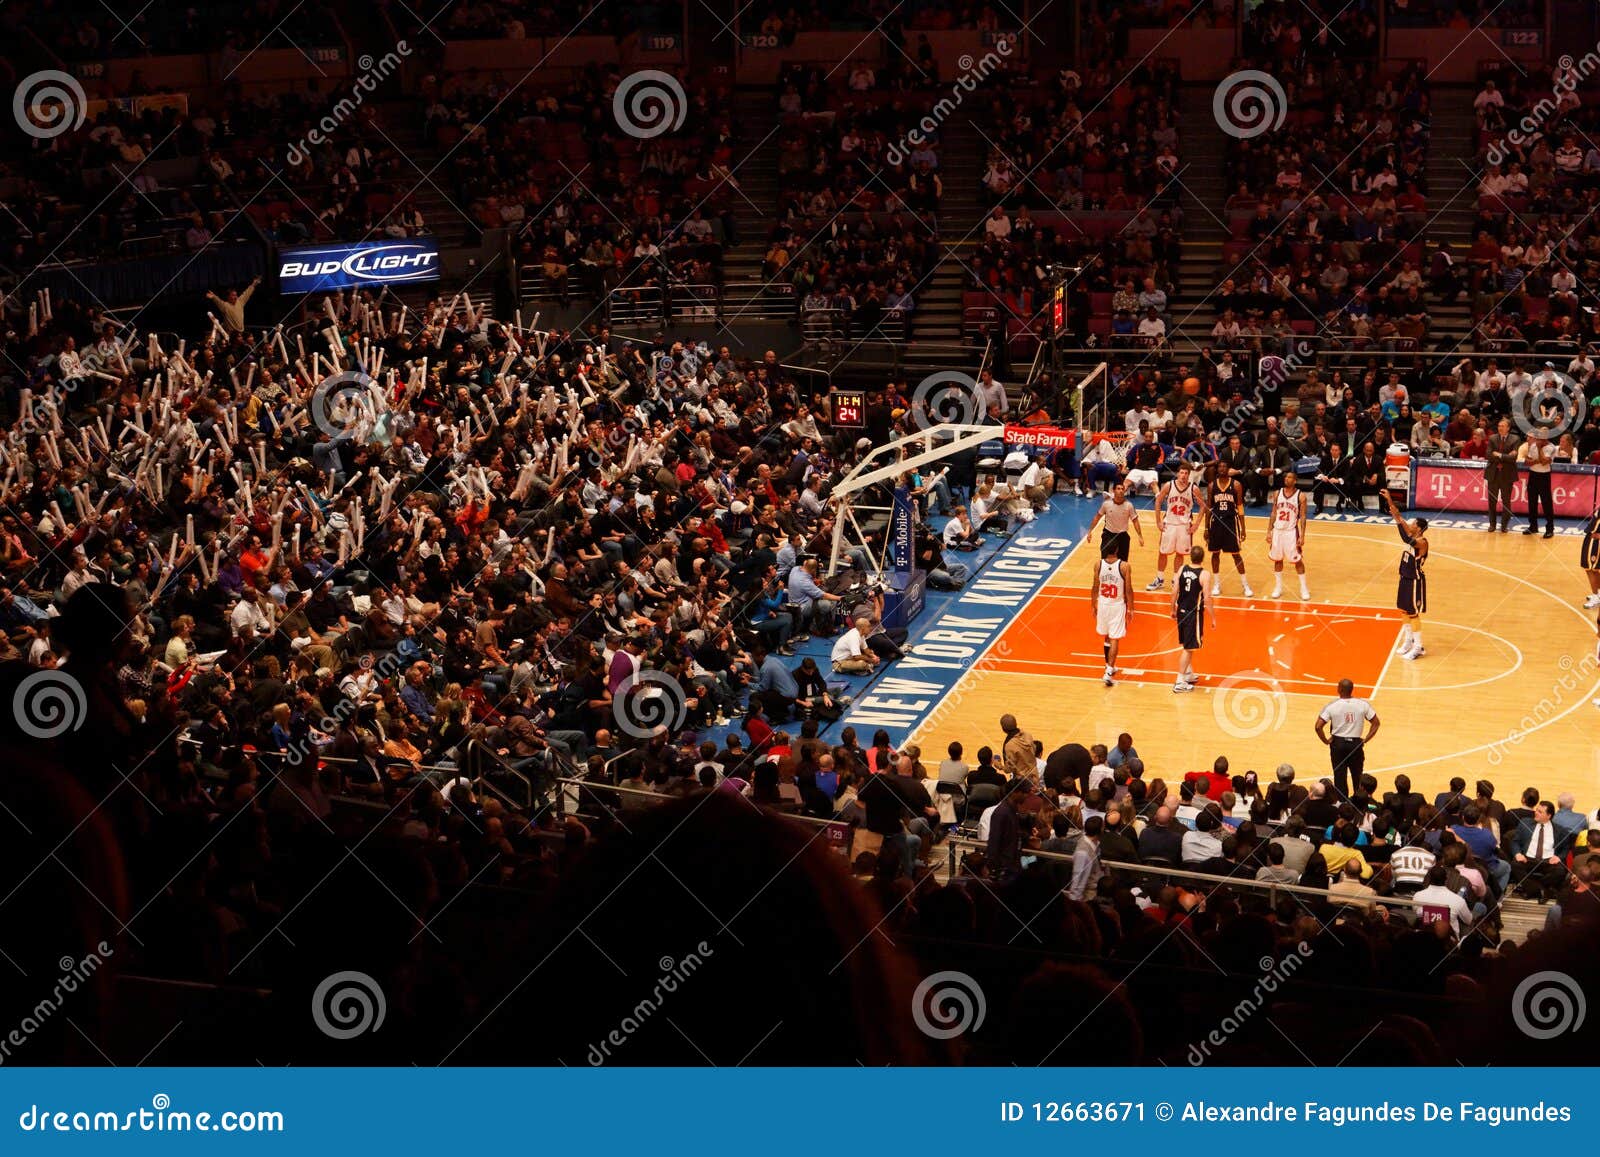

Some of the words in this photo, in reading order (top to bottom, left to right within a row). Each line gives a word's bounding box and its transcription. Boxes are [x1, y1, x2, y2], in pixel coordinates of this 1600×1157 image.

[752, 35, 778, 47] 120
[280, 261, 341, 278] BUD
[355, 252, 438, 271] LIGHT
[839, 408, 857, 420] 24
[1171, 504, 1186, 516] 42
[1219, 501, 1228, 511] 55
[1279, 511, 1290, 521] 21
[1101, 583, 1118, 599] 20
[1185, 578, 1191, 592] 3
[844, 677, 945, 728] NEW
[896, 614, 1004, 670] YORK
[958, 536, 1072, 607] KNICKS
[1402, 856, 1424, 869] 10
